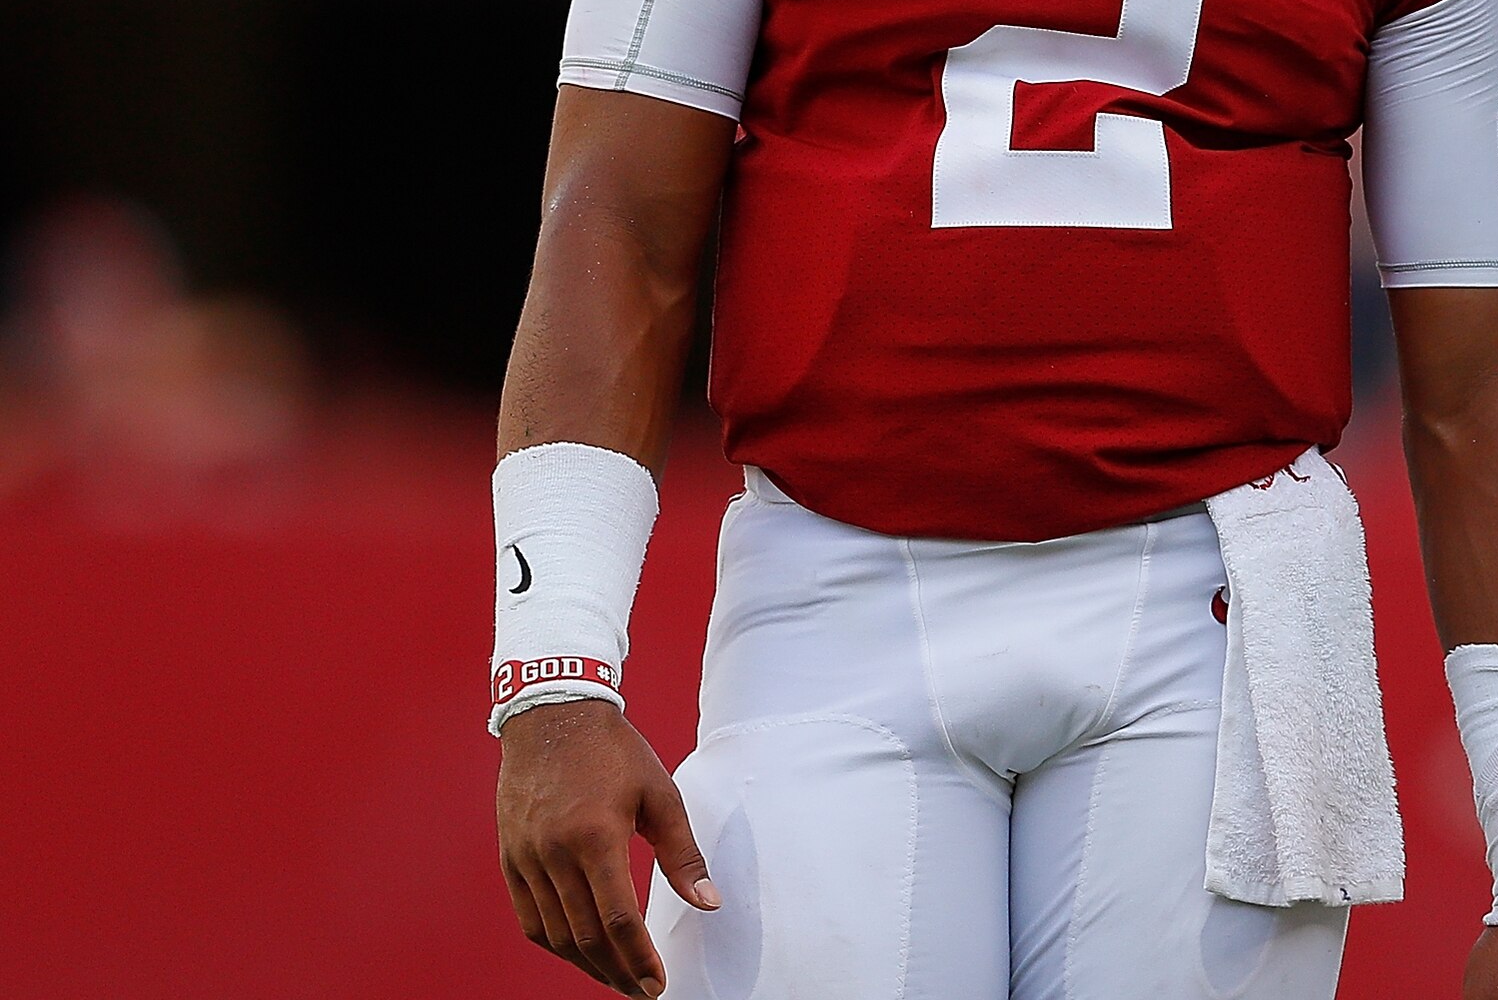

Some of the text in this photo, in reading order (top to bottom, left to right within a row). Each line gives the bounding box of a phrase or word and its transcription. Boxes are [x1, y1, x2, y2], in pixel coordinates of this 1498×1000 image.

[497, 663, 513, 700] 2
[520, 657, 584, 684] GOD
[1339, 887, 1352, 901] 2
